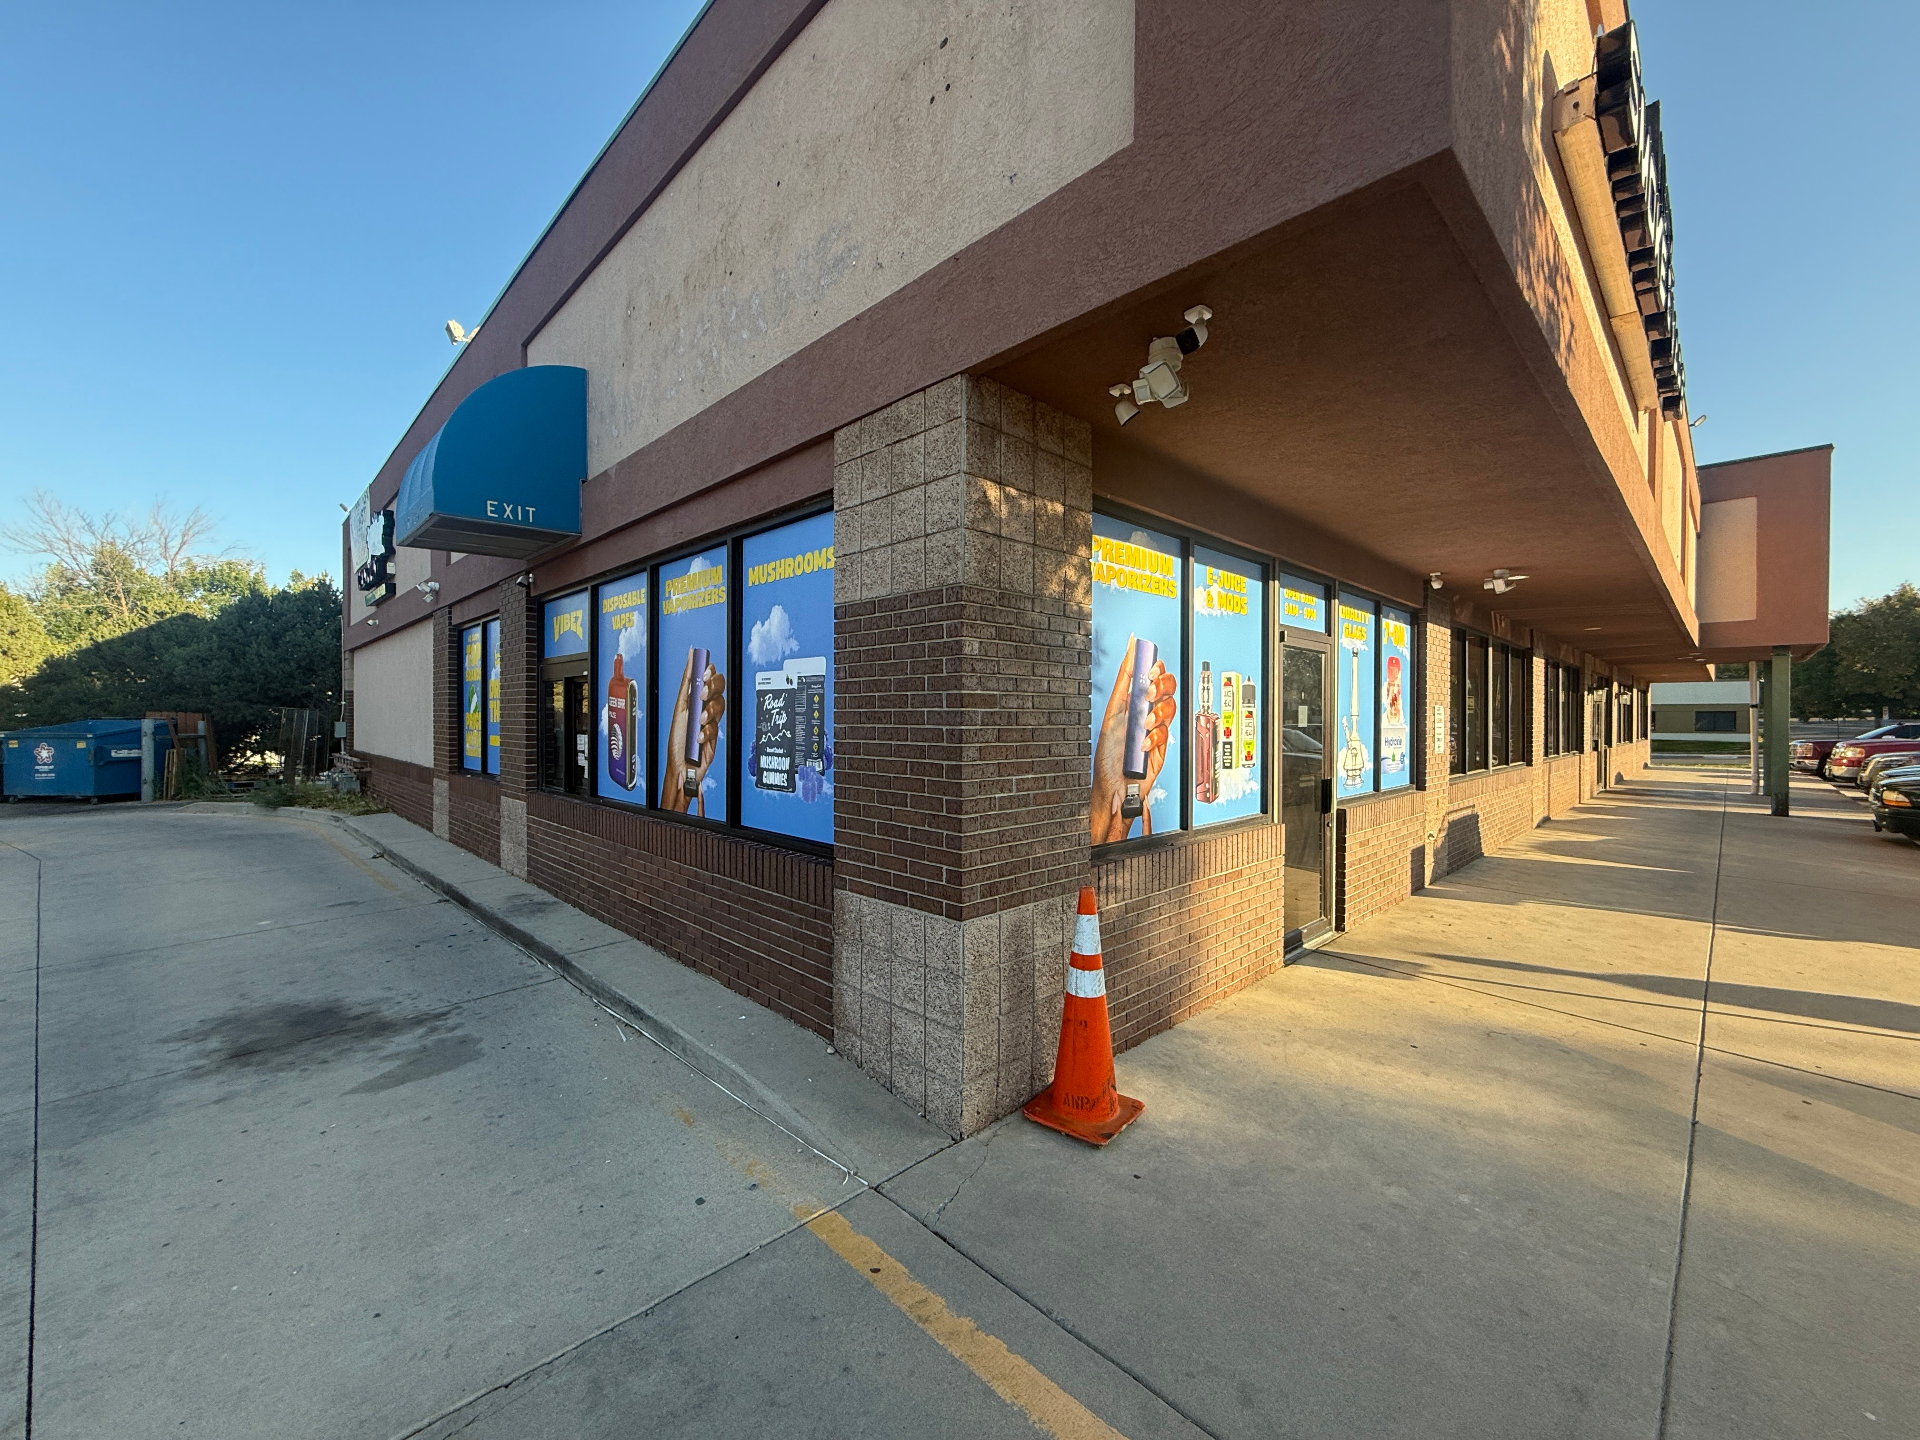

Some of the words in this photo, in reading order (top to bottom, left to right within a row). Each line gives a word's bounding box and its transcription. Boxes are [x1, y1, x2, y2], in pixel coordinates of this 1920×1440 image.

[486, 500, 536, 523] EXIT
[748, 545, 836, 588] MUSHROOMS
[1092, 534, 1174, 578] PREMIUM
[665, 565, 723, 598] PREMIUM
[1206, 566, 1247, 594] E-JUICE
[602, 588, 645, 614] DISPOSABLE
[662, 586, 726, 616] VAPORIZERS
[1206, 590, 1214, 609] &
[1217, 590, 1248, 616] MODS
[1284, 588, 1300, 602] OPEN
[1301, 591, 1316, 606] DAILY
[612, 611, 634, 631] VAPES
[1284, 602, 1299, 617] 9AM
[1304, 608, 1317, 621] 9PM
[1340, 605, 1370, 625] QUALITY
[553, 609, 583, 643] VIBEZ
[1343, 622, 1367, 642] GLASS
[763, 692, 787, 711] Road
[771, 709, 788, 730] Trip
[760, 755, 791, 771] MUSHROOM
[762, 771, 788, 787] GUMMIES
